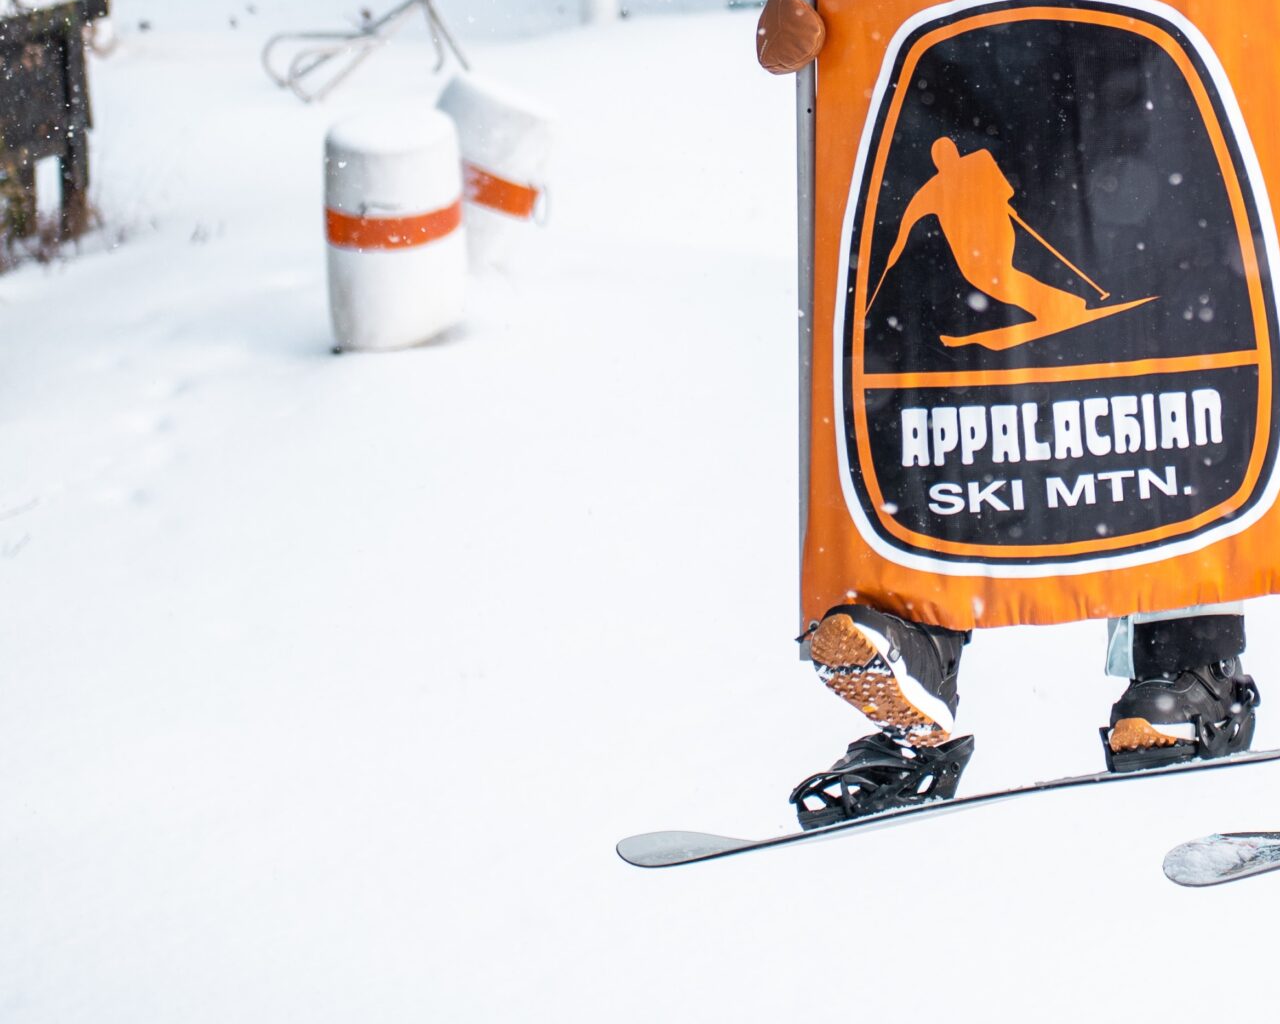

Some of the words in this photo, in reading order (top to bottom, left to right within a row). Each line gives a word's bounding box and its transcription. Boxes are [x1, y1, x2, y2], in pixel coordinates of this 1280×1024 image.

[901, 388, 1223, 467] APPALACHIAN
[928, 479, 1025, 515] SKI
[1045, 465, 1192, 508] MTN.
